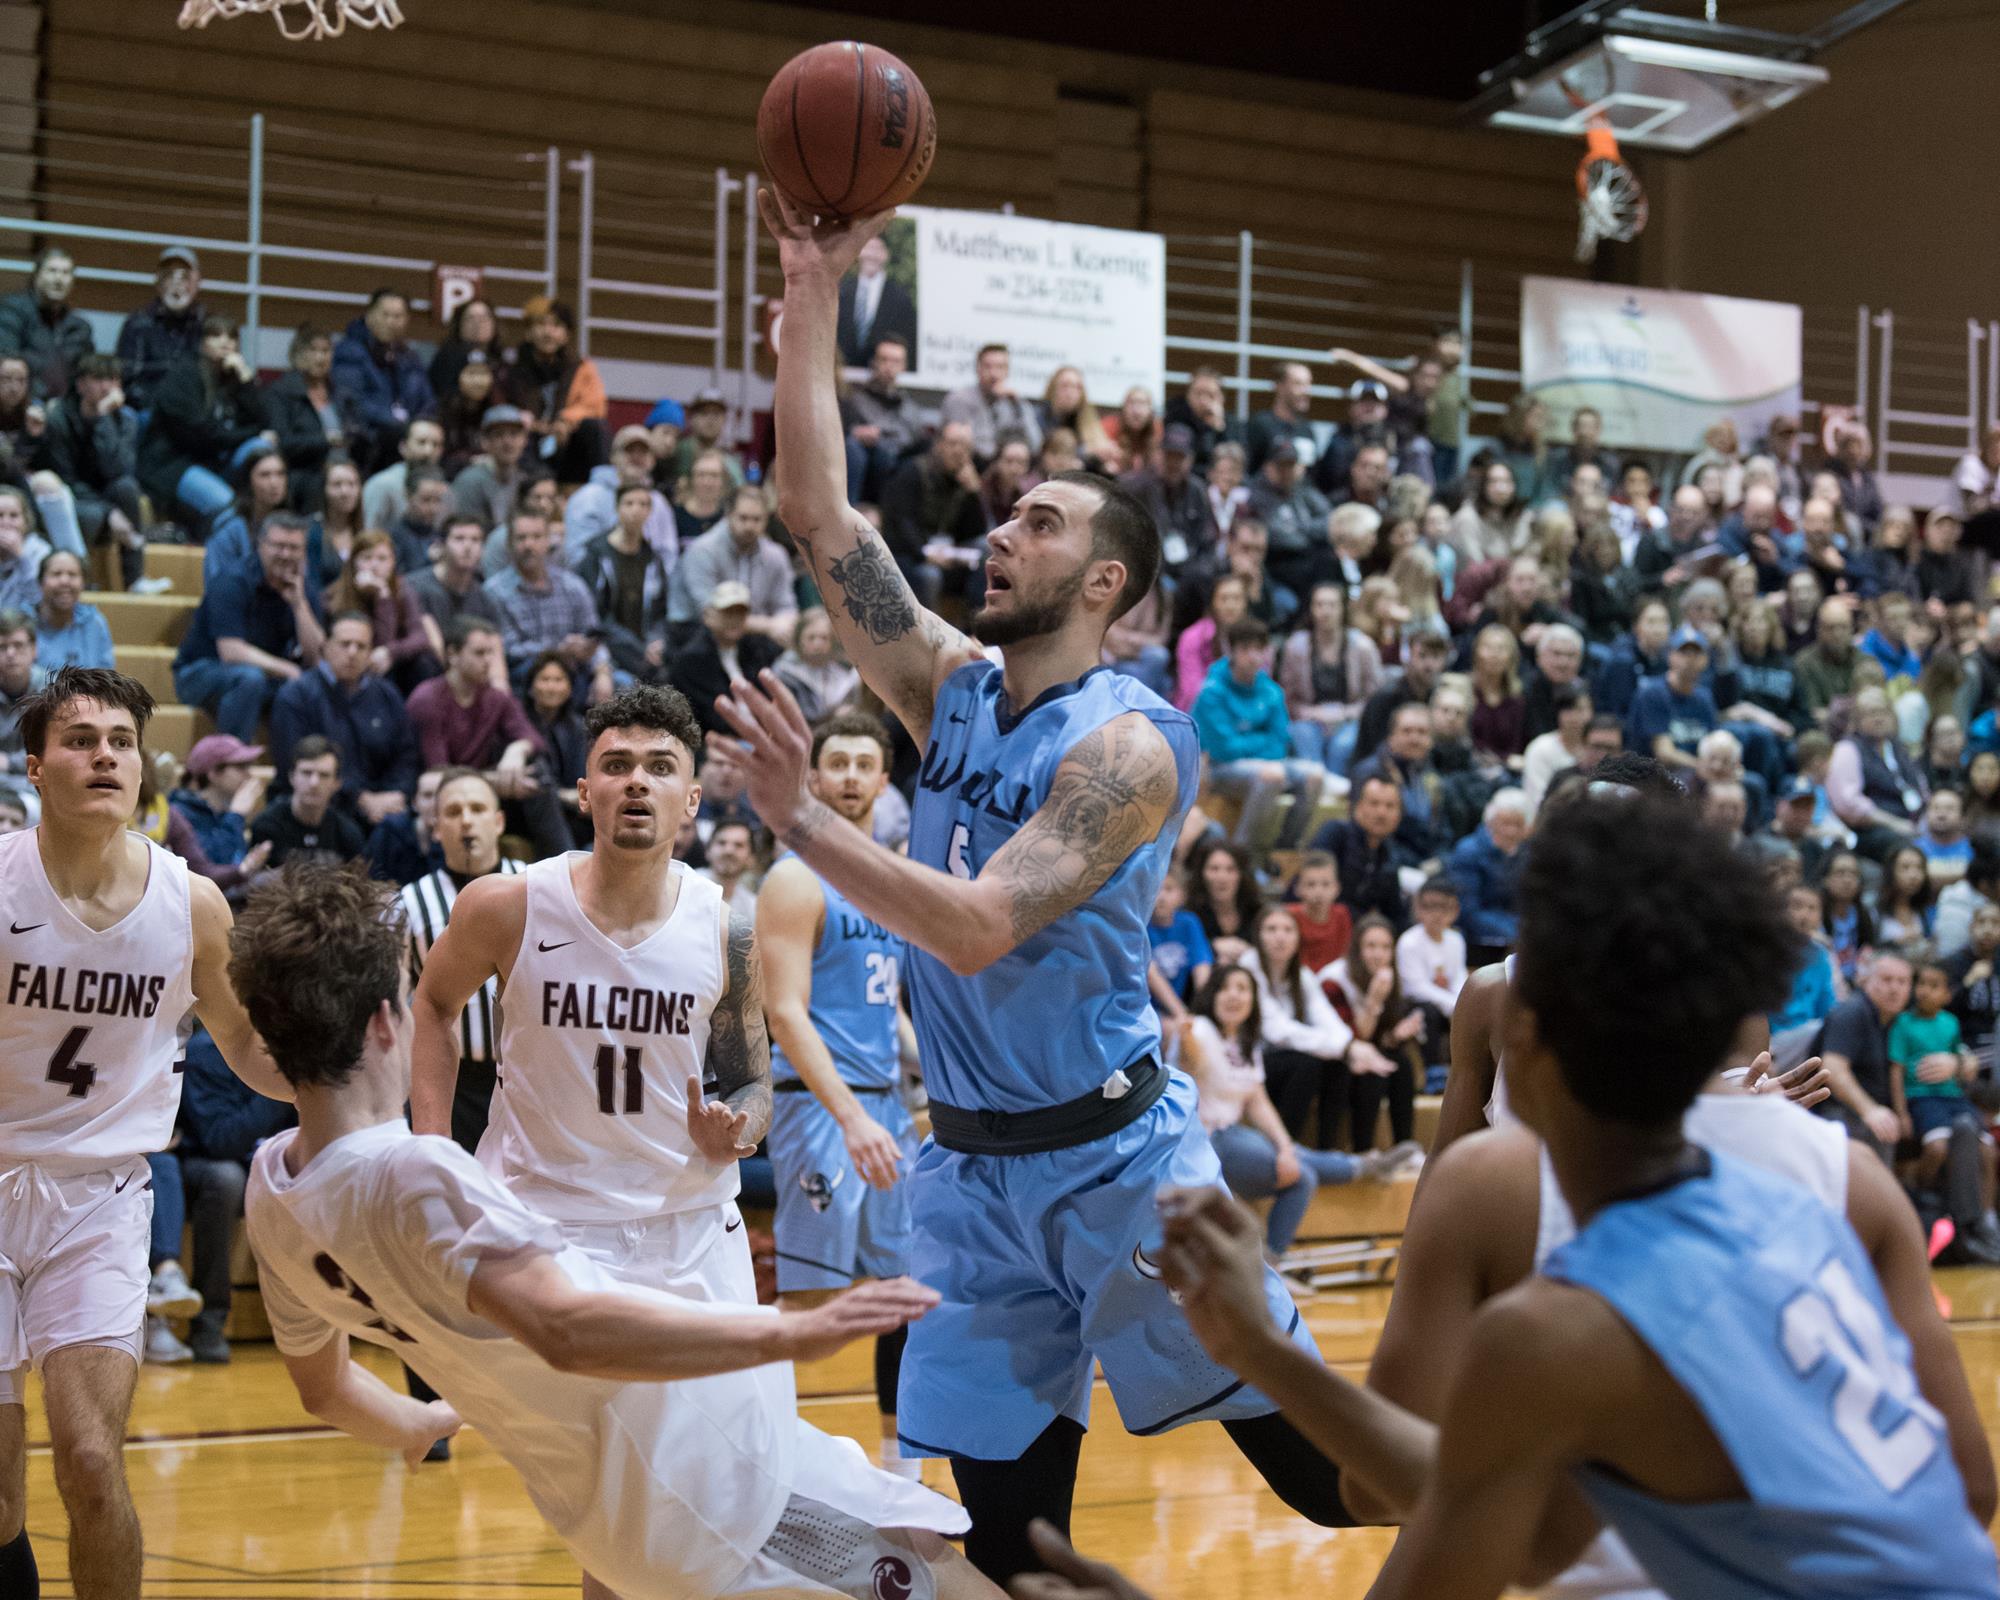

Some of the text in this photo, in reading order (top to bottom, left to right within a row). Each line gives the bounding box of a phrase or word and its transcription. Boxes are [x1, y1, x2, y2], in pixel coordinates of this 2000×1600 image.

[931, 229, 1040, 267] Matthew
[1070, 242, 1152, 287] Koenig
[441, 278, 475, 325] P
[7, 962, 166, 1019] FALCONS
[542, 980, 695, 1035] FALCONS
[44, 1025, 98, 1099] 4
[593, 1042, 645, 1116] 11
